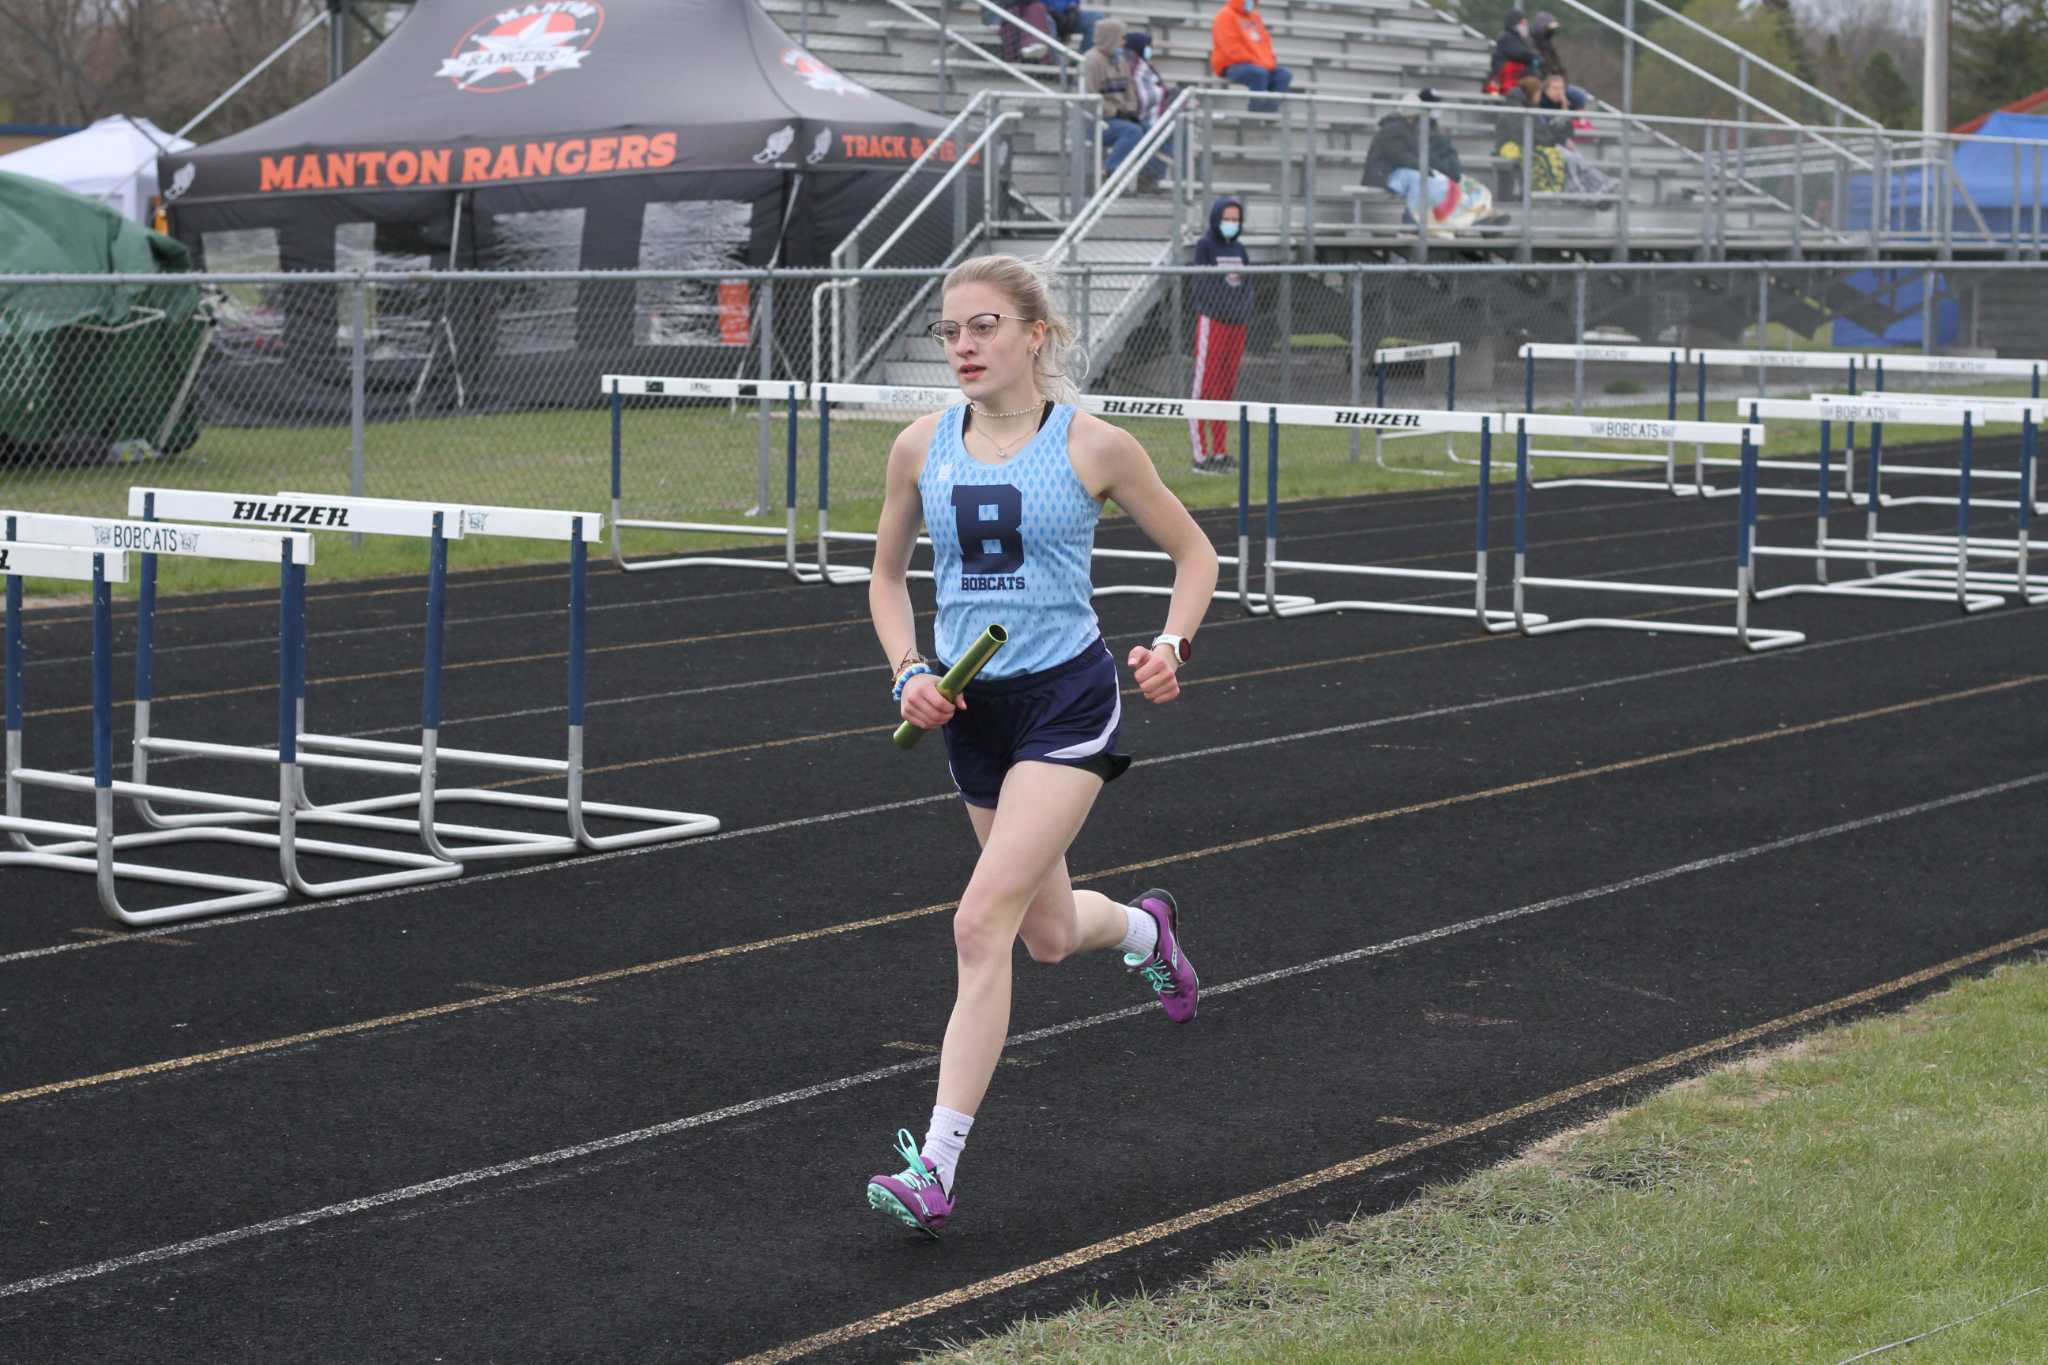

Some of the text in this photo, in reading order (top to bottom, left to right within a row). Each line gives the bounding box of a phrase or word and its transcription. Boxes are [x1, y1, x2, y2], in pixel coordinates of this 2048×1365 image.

[467, 50, 560, 66] RANGERS
[842, 134, 906, 159] TRACK
[259, 132, 678, 192] MANTON RANGERS
[1102, 401, 1184, 416] BLAZER
[1835, 405, 1885, 420] BOBCATS
[1334, 411, 1421, 427] BLAZER
[1607, 422, 1659, 438] BOBCATS
[231, 500, 349, 527] BLAZER
[951, 484, 1025, 575] B
[113, 525, 178, 552] BOBCATS
[961, 576, 1026, 591] BOBCATS
